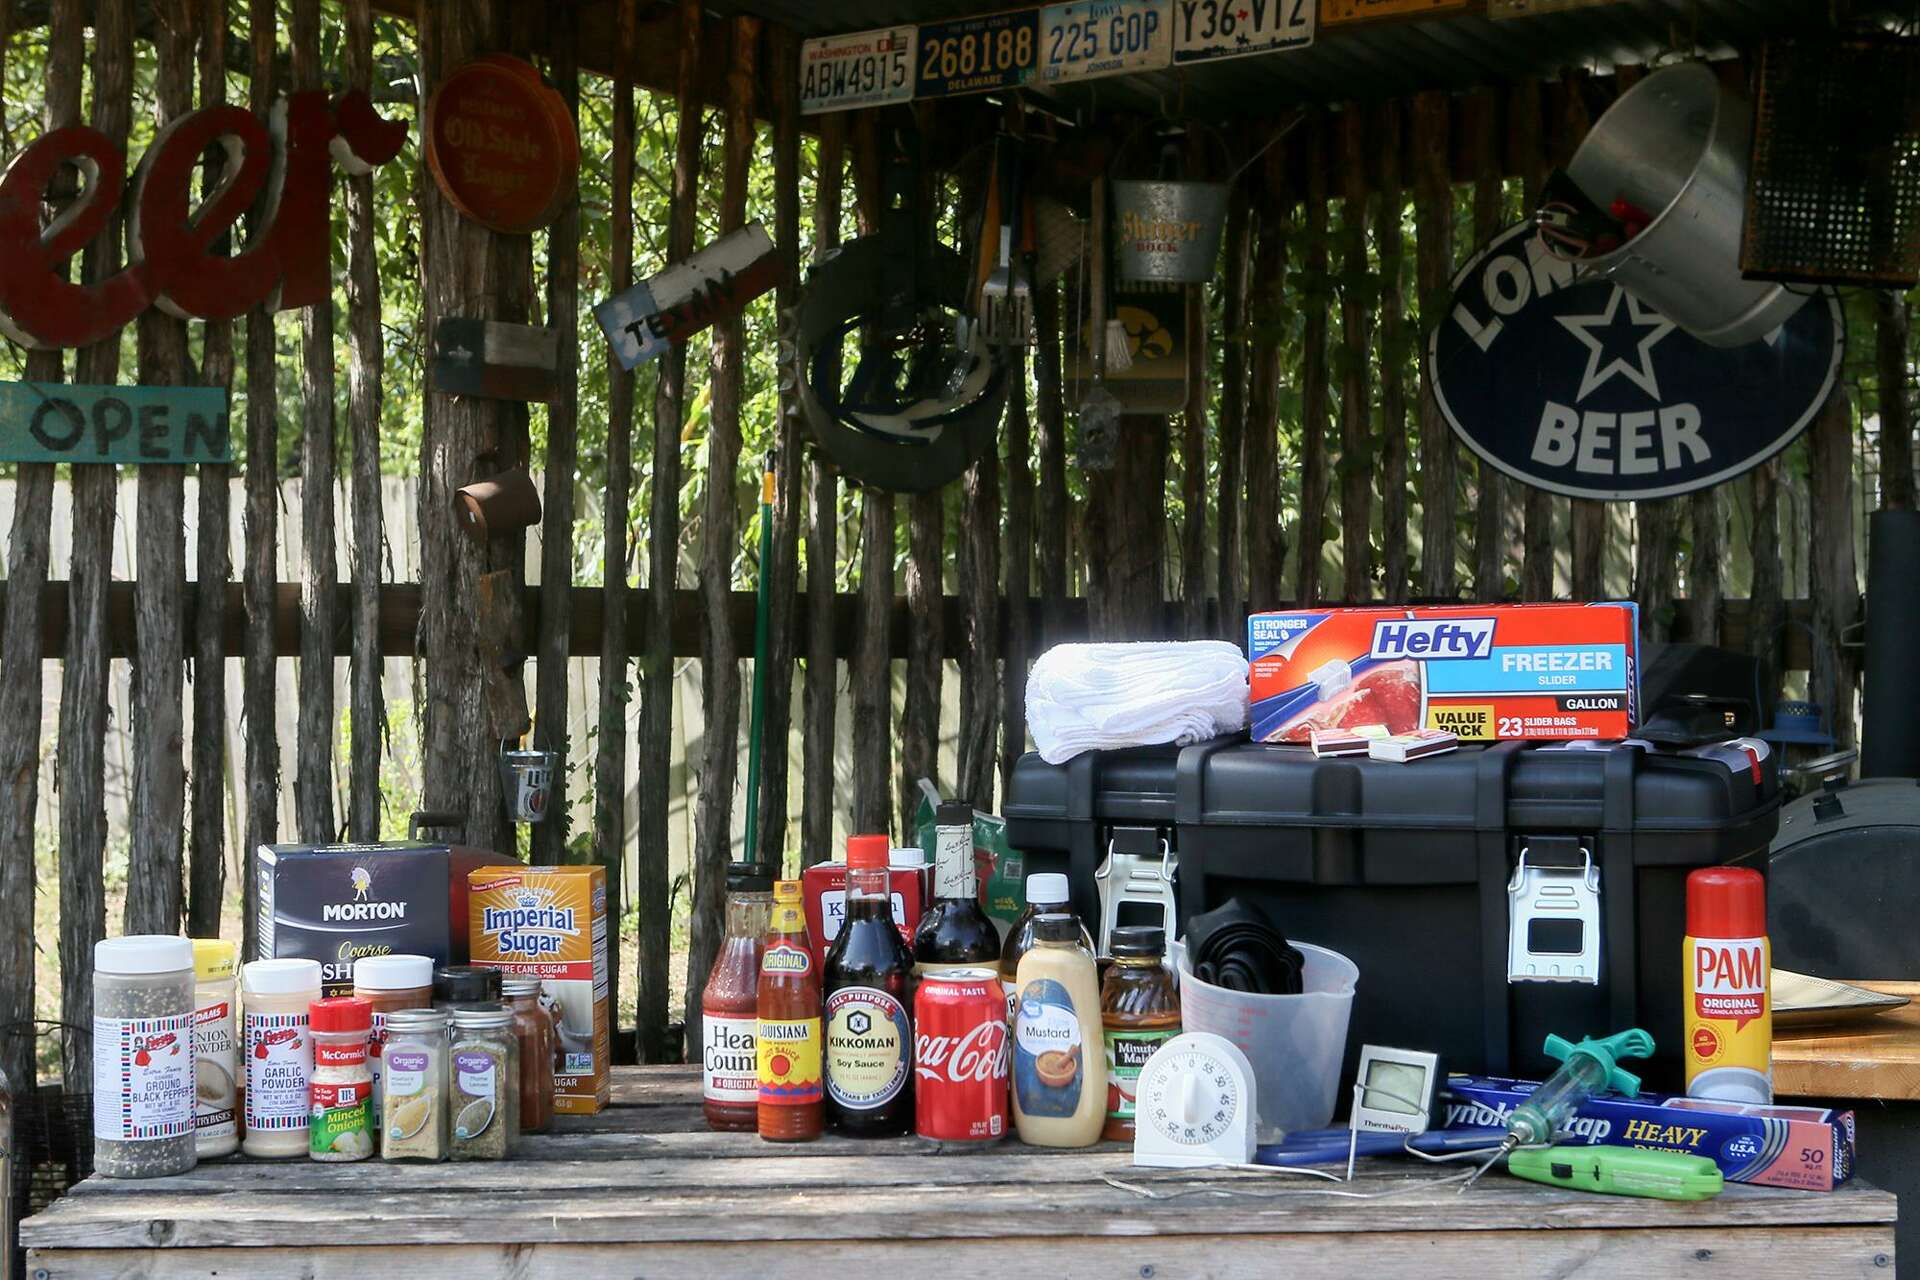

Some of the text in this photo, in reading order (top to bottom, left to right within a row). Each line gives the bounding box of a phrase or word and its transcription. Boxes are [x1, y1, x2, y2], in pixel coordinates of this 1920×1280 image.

[1181, 0, 1236, 43] Y36
[1050, 10, 1158, 65] 225 GOP
[808, 43, 872, 61] WASHINGTON
[922, 26, 1032, 81] 268188
[803, 52, 907, 100] ABW4915
[947, 74, 1003, 91] DELAWARE
[1135, 243, 1179, 253] BOCK
[1452, 233, 1592, 353] LON
[30, 397, 228, 458] OPEN
[1530, 400, 1712, 476] BEER
[1253, 619, 1308, 630] STRONGER
[1253, 629, 1280, 641] SEAL
[1378, 625, 1490, 660] Hefty
[1502, 651, 1613, 673] FREEZER
[1538, 675, 1577, 686] SLIDER
[1566, 698, 1619, 710] GALLON
[1435, 711, 1487, 724] VALUE
[1525, 716, 1577, 727] SLIDER BAGS
[1498, 717, 1523, 737] 23
[323, 902, 405, 922] MORTON
[484, 905, 573, 932] Imperial
[337, 941, 392, 961] Coarse
[499, 931, 561, 955] Sugar
[764, 953, 805, 968] ORIGINAL
[1696, 946, 1763, 989] PAM
[516, 965, 538, 974] CANE
[540, 965, 568, 974] SUGAR
[925, 985, 986, 996] ORIGINAL TASTE
[1702, 998, 1759, 1009] ORIGINAL
[196, 1007, 222, 1021] DAMS
[196, 1029, 229, 1043] NION
[713, 1025, 758, 1050] Hea
[759, 1024, 808, 1040] LOUISIANA
[1025, 1026, 1071, 1039] Mustard
[196, 1040, 232, 1054] WDER
[829, 1036, 894, 1049] KIKKOMAN
[914, 1018, 1008, 1083] ca-Cola
[1118, 1042, 1158, 1054] Minute
[392, 1056, 425, 1067] Organic
[458, 1056, 489, 1067] Organic
[836, 1059, 885, 1068] Soy Sauce
[264, 1066, 302, 1078] GARLIC
[146, 1078, 181, 1092] GROUND
[261, 1077, 305, 1089] POWDER
[554, 1078, 577, 1087] UGAR
[722, 1079, 758, 1090] ORIGINA
[133, 1087, 189, 1103] BLACK PEPPER
[327, 1104, 366, 1123] Minced
[1444, 1101, 1519, 1129] ynol
[327, 1118, 365, 1133] Onions
[1364, 1119, 1410, 1136] ThermoPro
[1558, 1107, 1612, 1144] rap
[1623, 1119, 1708, 1147] HEAVY
[1800, 1148, 1824, 1164] 50
